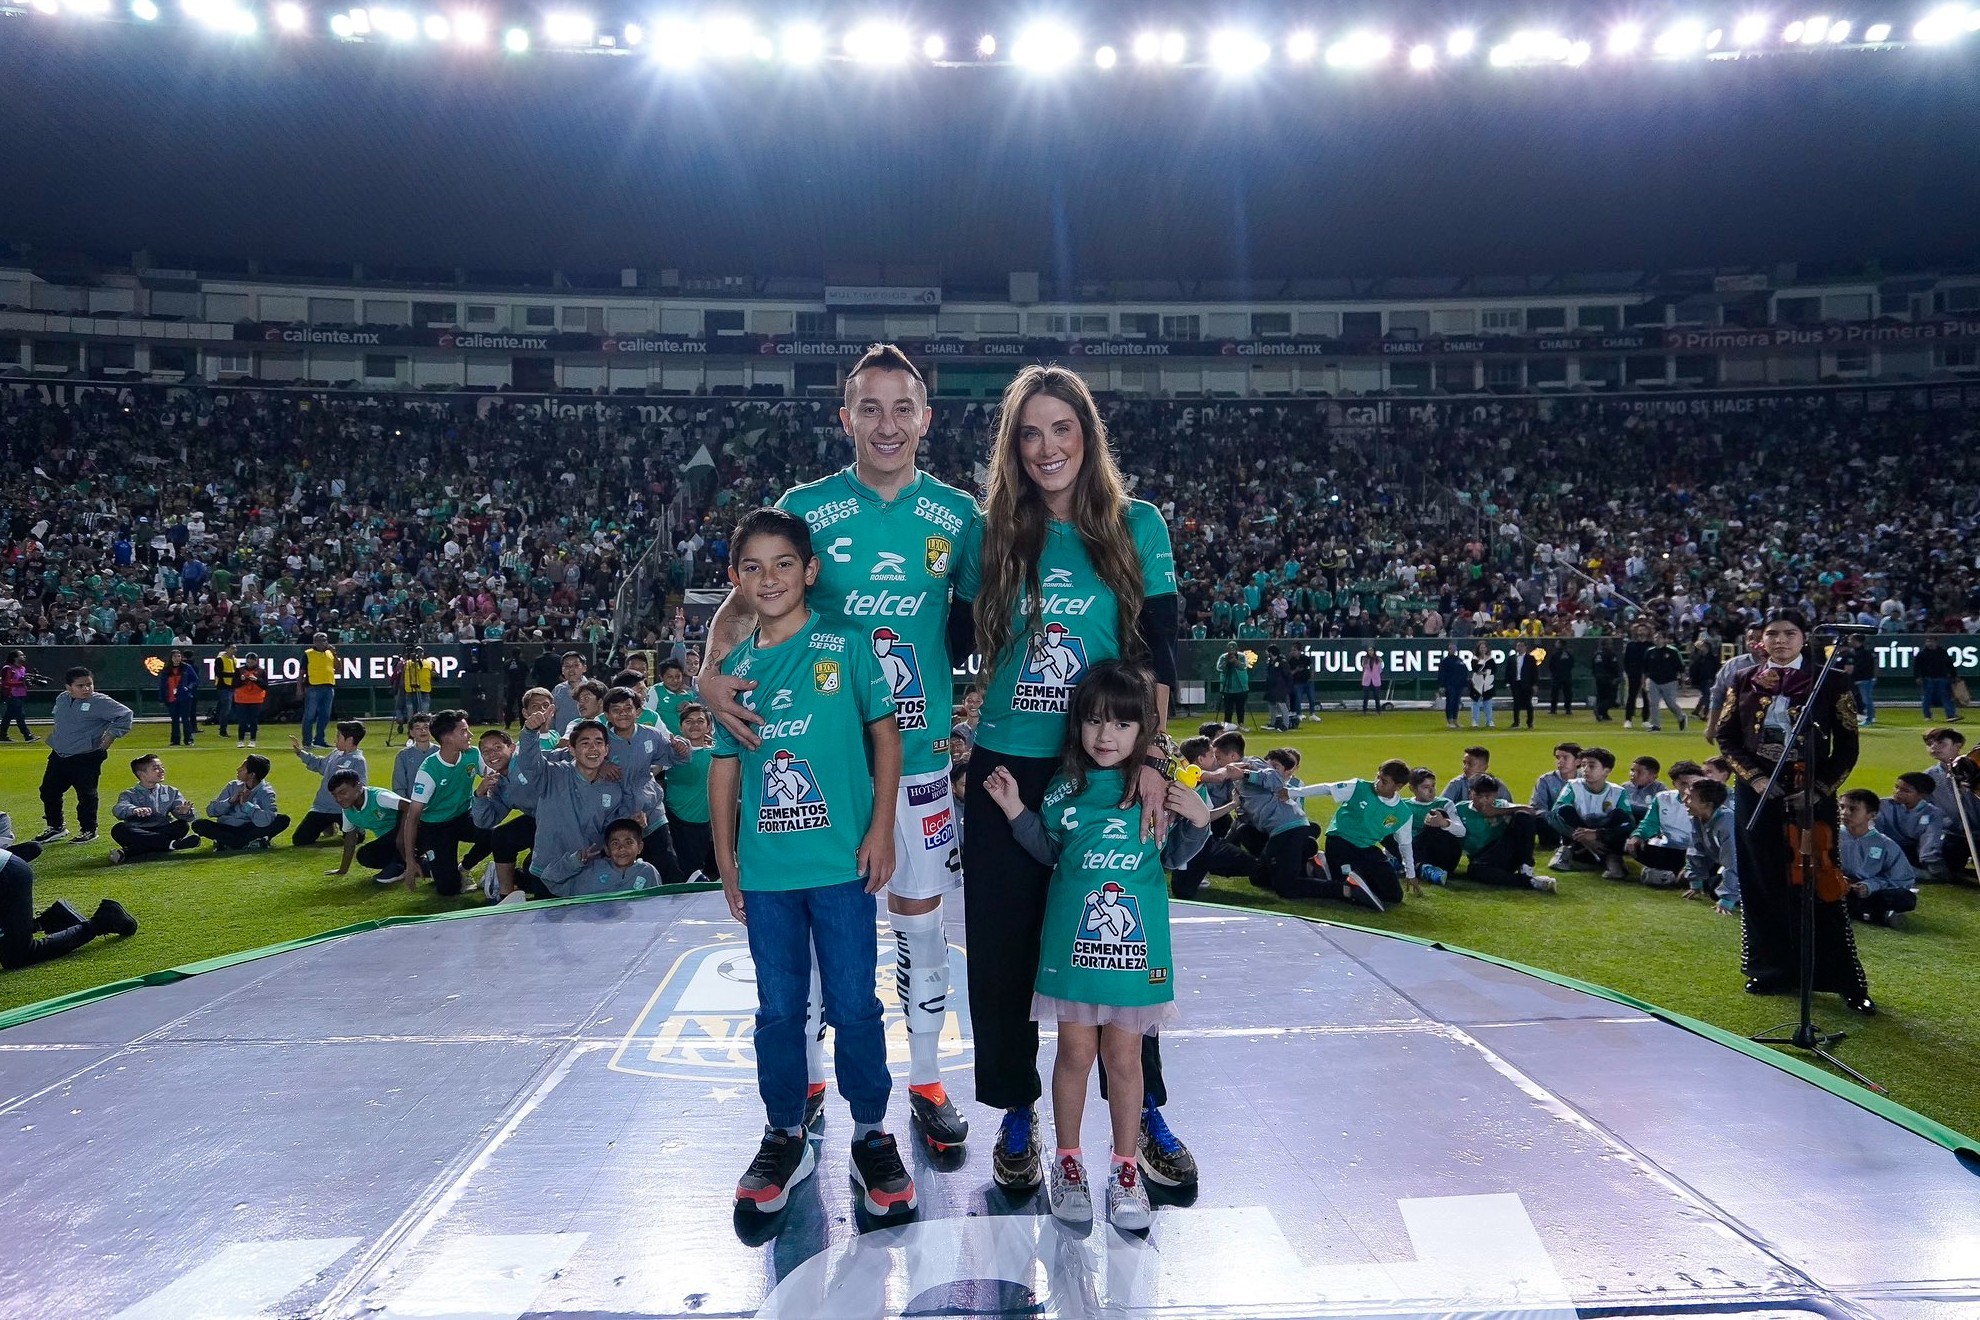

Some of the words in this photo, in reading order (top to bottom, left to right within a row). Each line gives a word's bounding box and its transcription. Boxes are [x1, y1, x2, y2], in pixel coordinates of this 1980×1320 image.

[283, 327, 380, 345] caliente.mx
[1686, 332, 1769, 349] Primera
[1775, 329, 1823, 345] Plus
[1847, 325, 1936, 342] Primera
[455, 334, 547, 350] caliente.mx
[618, 338, 707, 353] caliente.mx
[776, 341, 862, 355] caliente.mx
[925, 344, 964, 354] CHARLY
[985, 344, 1024, 354] CHARLY
[1084, 343, 1169, 355] caliente.mx
[1236, 342, 1322, 355] caliente.mx
[1384, 342, 1424, 353] CHARLY
[1444, 340, 1485, 351] CHARLY
[1539, 339, 1582, 350] CHARLY
[1602, 337, 1645, 349] CHARLY
[1713, 397, 1755, 413] HACE
[805, 497, 857, 524] Office
[917, 496, 963, 530] Office
[811, 505, 861, 534] DEPOT
[913, 506, 960, 536] DEPOT
[843, 590, 927, 616] telcel
[808, 642, 844, 653] DEPOT
[811, 633, 845, 646] Office
[1390, 650, 1422, 672] EN
[1874, 641, 1979, 668] TÍTOS
[1015, 685, 1074, 699] CEMENT
[1012, 697, 1068, 712] FORTAL
[759, 803, 827, 820] CEMENTOS
[758, 816, 830, 833] FORTALEZA
[925, 813, 950, 834] lech
[1081, 849, 1143, 871] telcel
[1074, 941, 1147, 956] CEMENTOS
[1072, 954, 1148, 970] FORTALEZA
